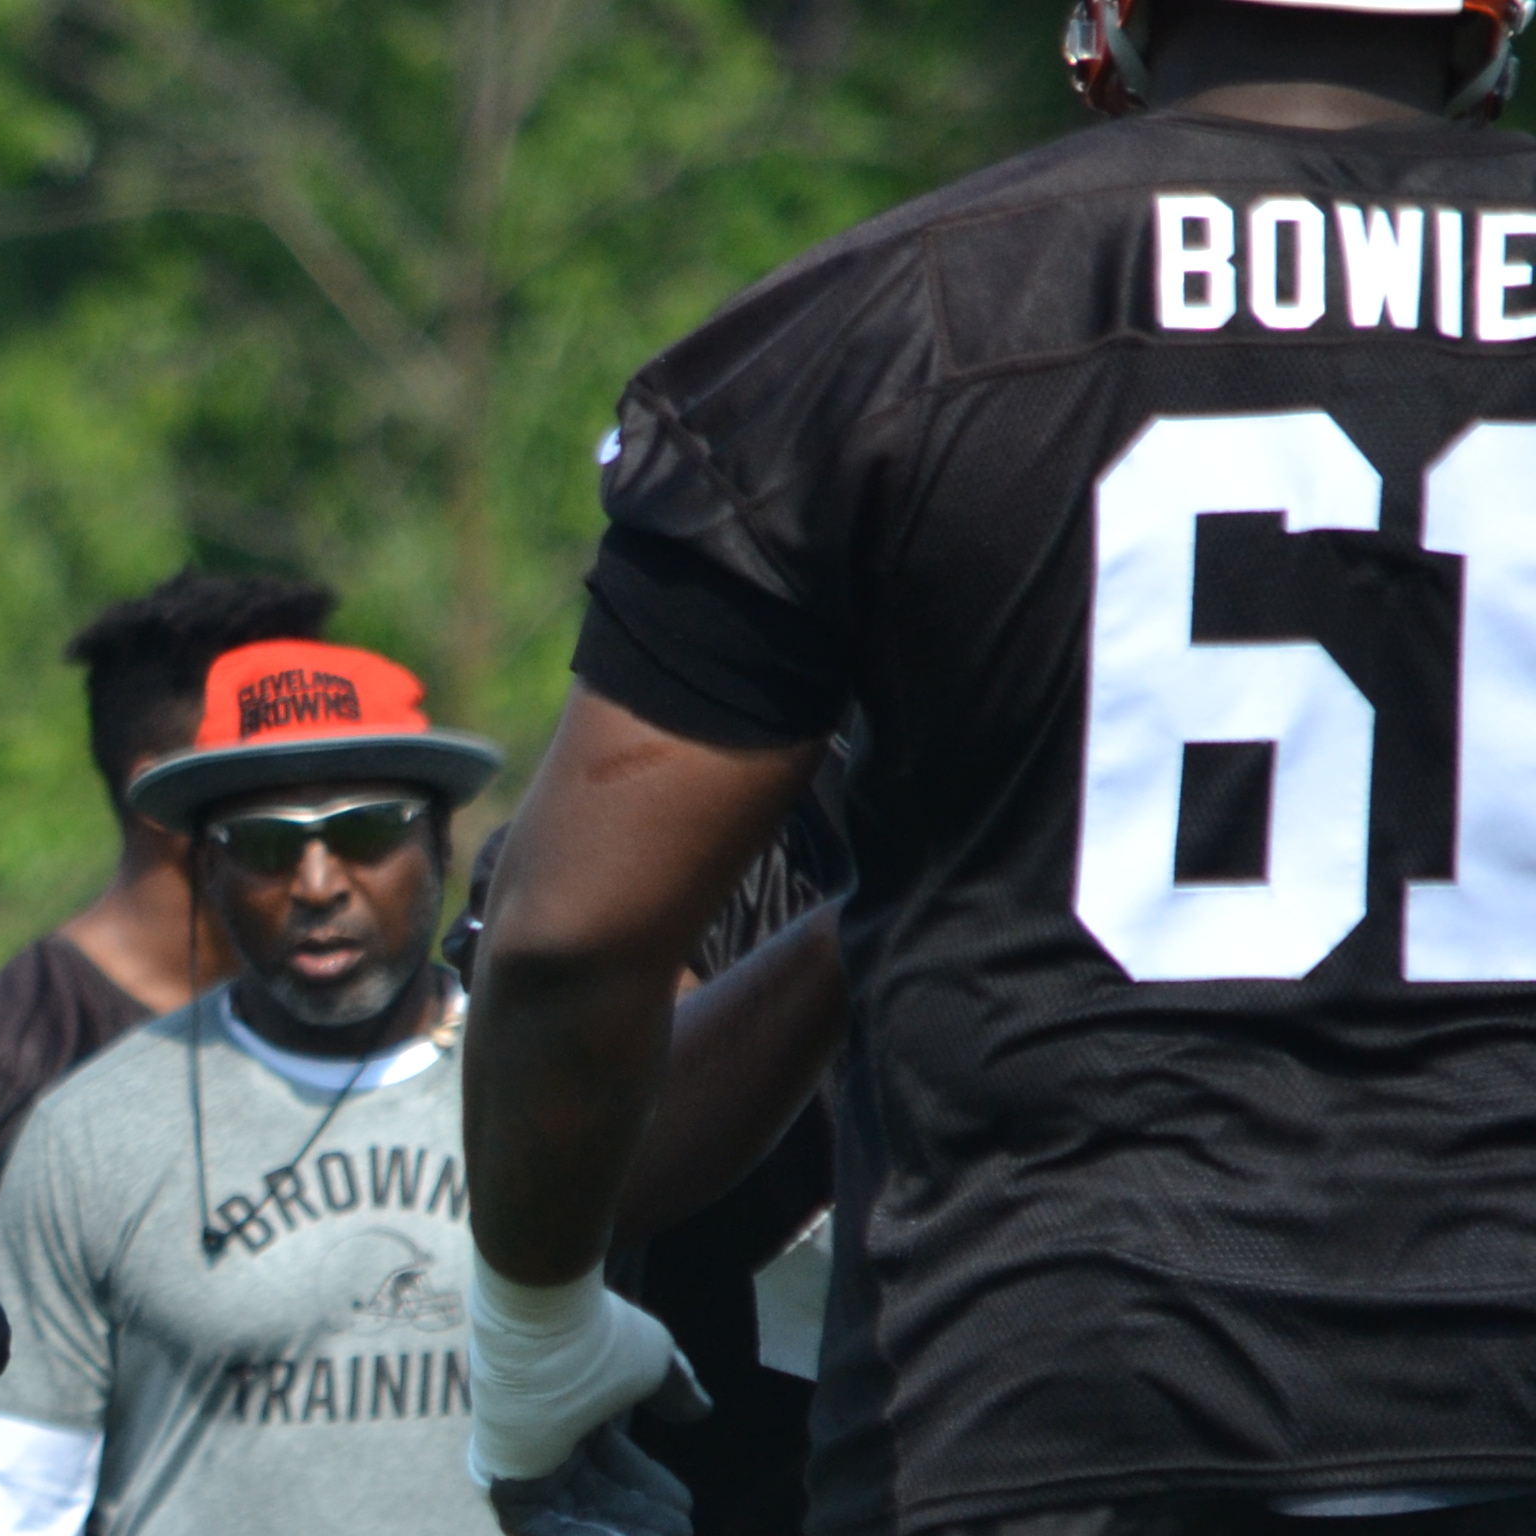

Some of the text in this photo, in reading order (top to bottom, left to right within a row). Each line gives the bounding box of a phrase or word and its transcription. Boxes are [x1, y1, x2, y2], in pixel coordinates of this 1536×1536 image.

[1154, 195, 1536, 341] BOWIE
[1072, 410, 1536, 982] 61
[215, 1143, 469, 1255] BROWN
[227, 1350, 472, 1425] TRAININ
